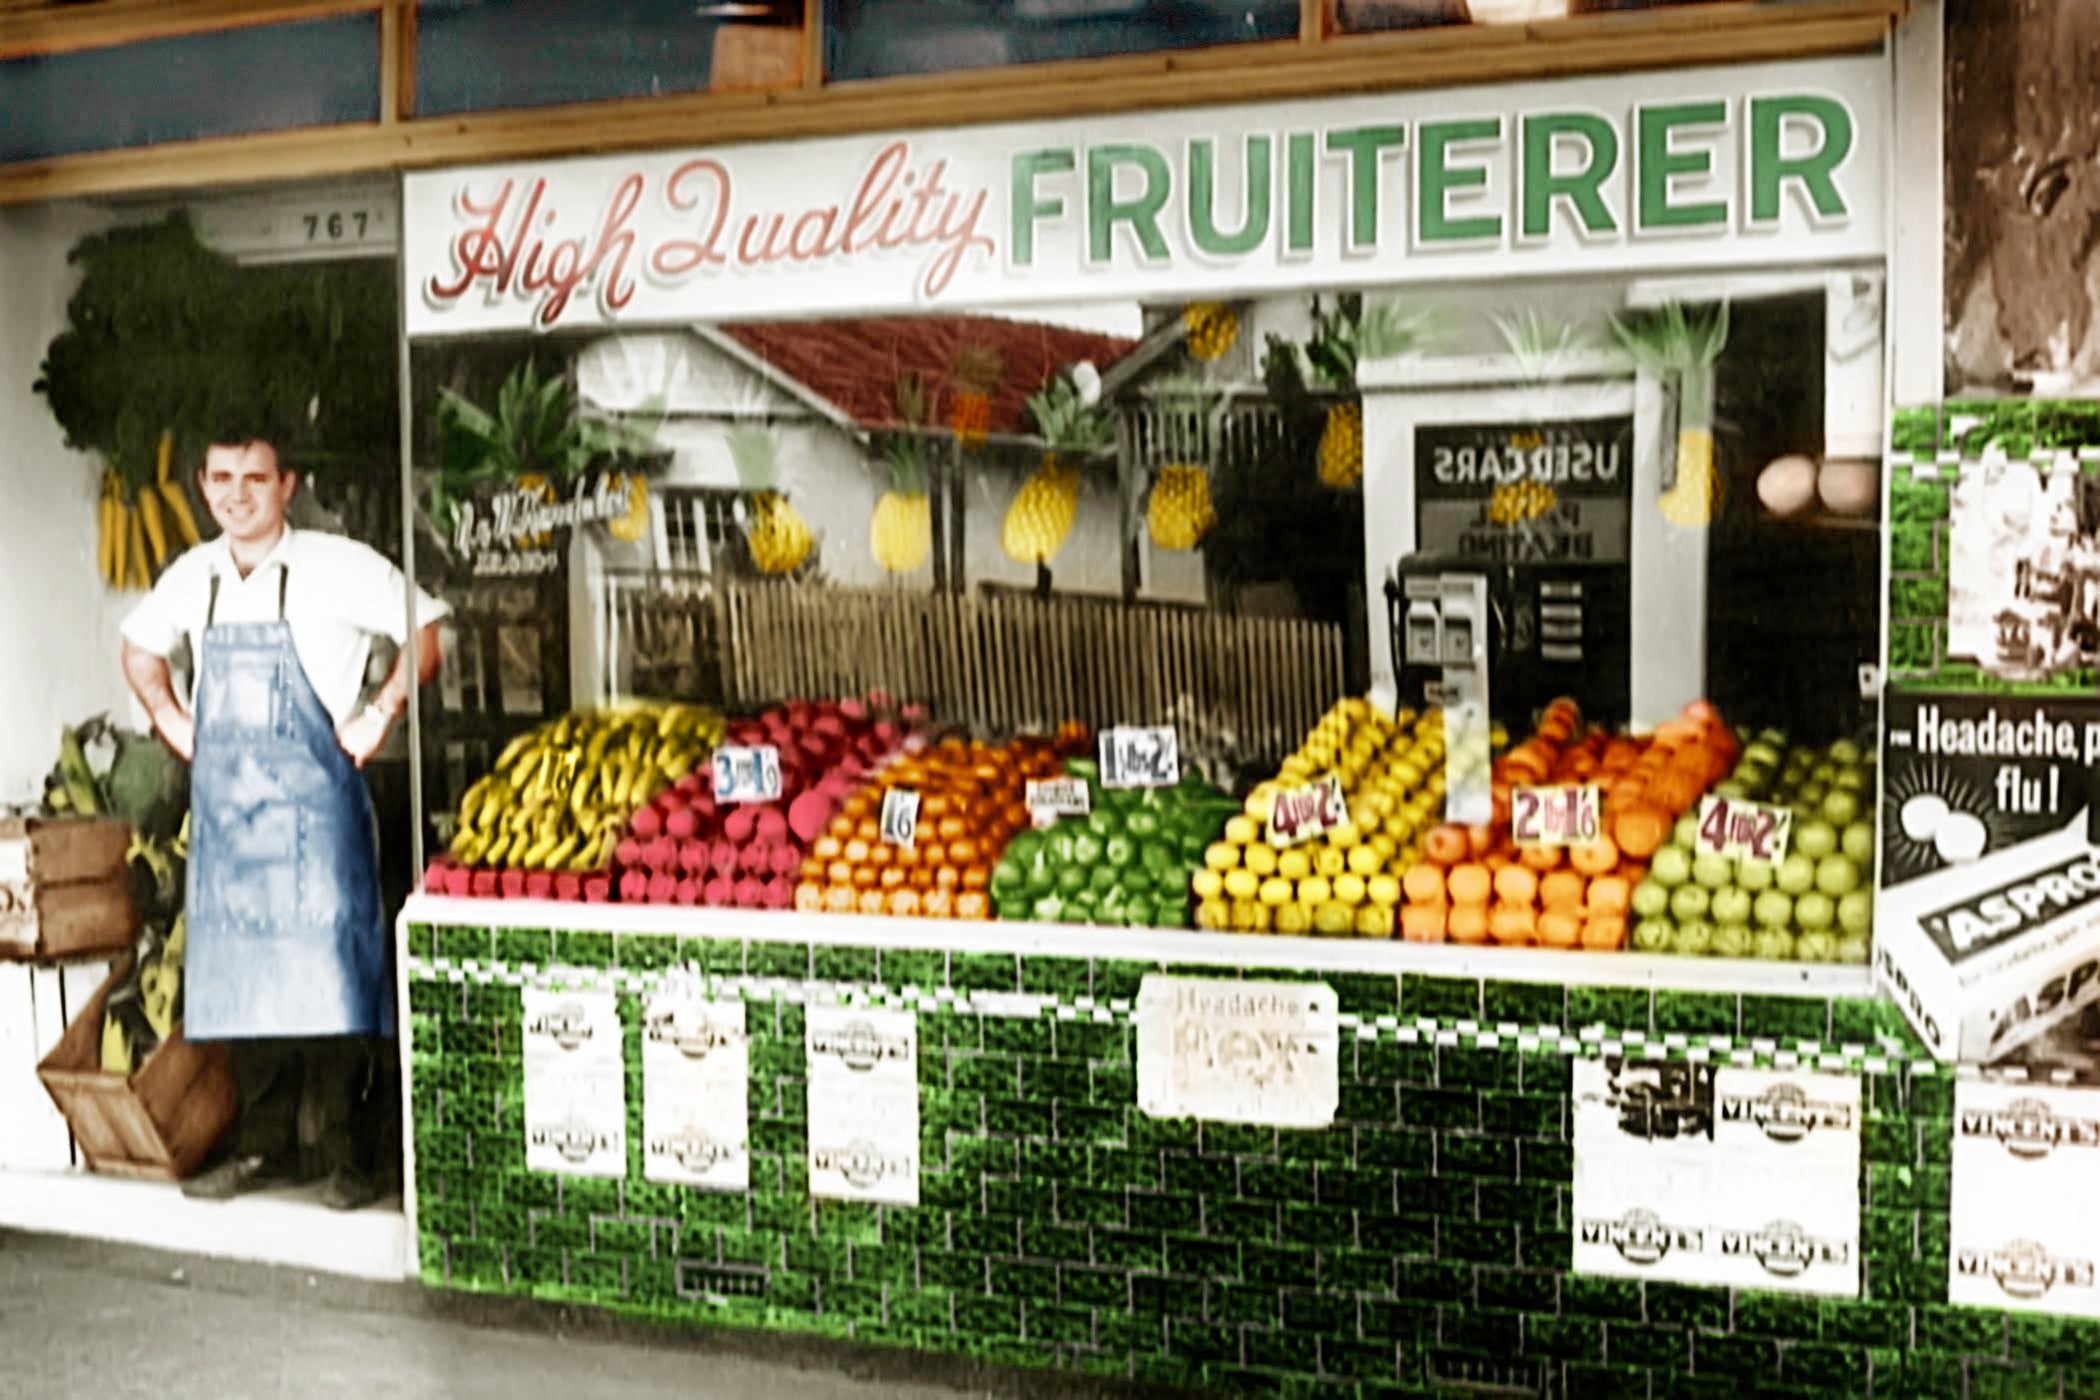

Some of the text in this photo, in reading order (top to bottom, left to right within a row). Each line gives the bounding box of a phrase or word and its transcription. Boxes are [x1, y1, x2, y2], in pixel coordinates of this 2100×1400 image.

[301, 210, 370, 241] 767
[425, 92, 1857, 327] High Quality FRUITERER
[1917, 704, 2079, 761] Headache,
